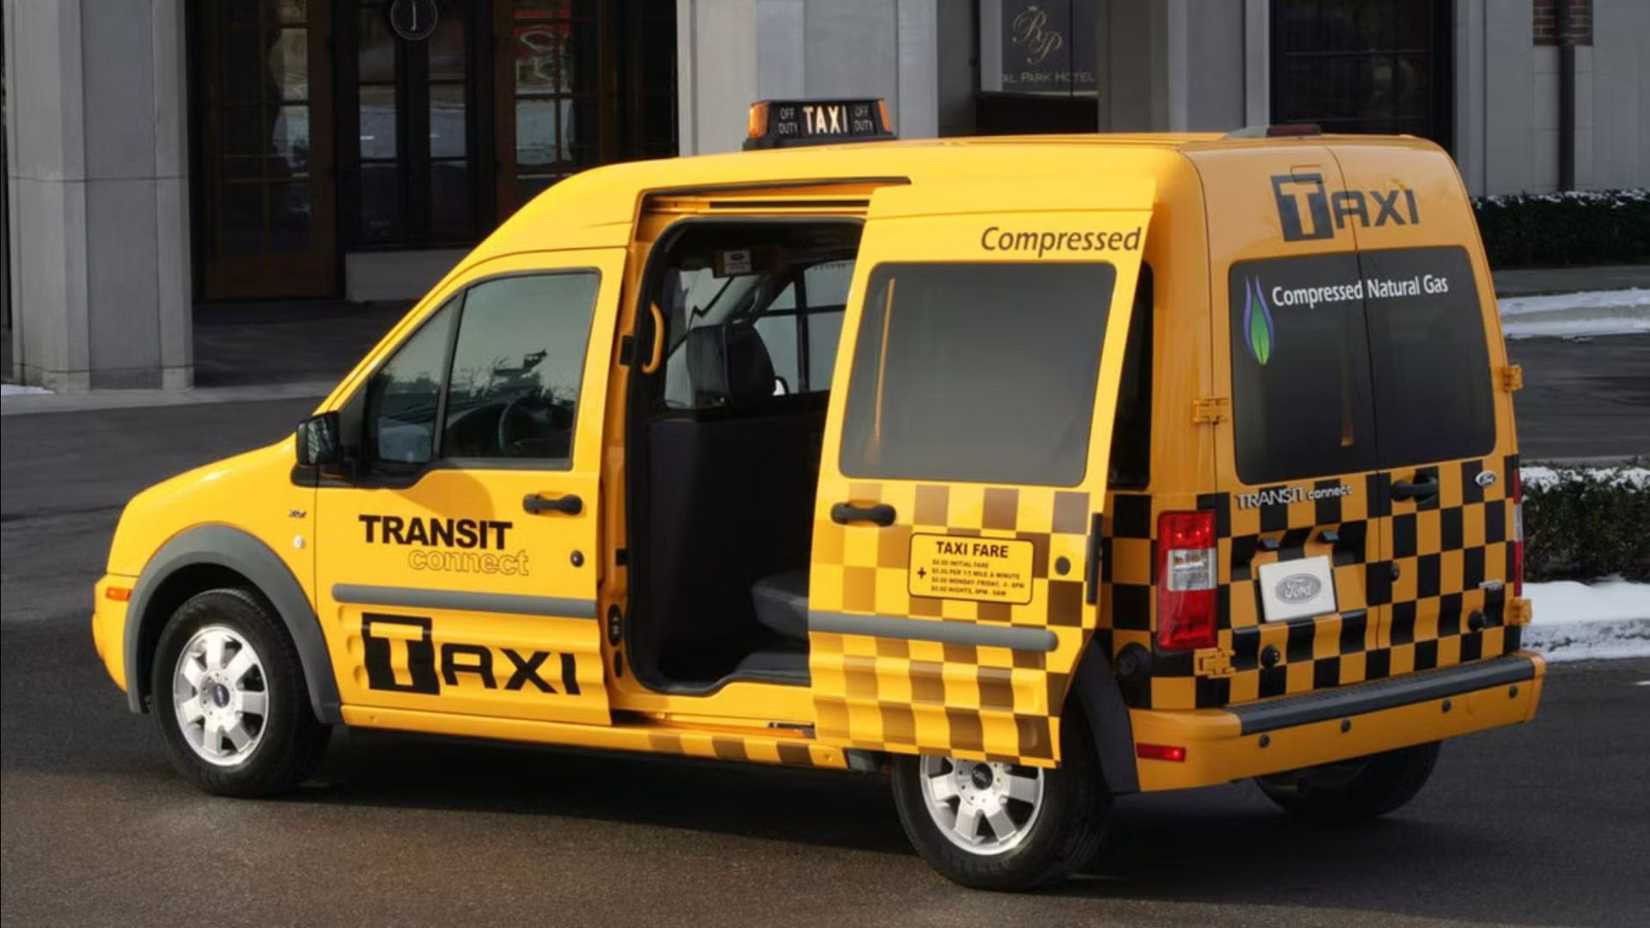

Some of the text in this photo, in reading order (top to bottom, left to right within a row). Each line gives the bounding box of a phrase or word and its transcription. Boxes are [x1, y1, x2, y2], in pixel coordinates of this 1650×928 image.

[780, 106, 795, 120] OFF
[802, 105, 848, 135] TAXI
[855, 105, 869, 118] OFF
[778, 122, 799, 134] DUTY
[854, 120, 873, 132] DUTY
[981, 226, 1142, 258] Compressed
[1272, 274, 1449, 308] Compressed Natural Gas
[1237, 484, 1353, 510] TRANSIT connect
[358, 514, 513, 550] TRANSIT
[408, 550, 530, 576] connect
[936, 541, 1009, 559] TAXI FARE
